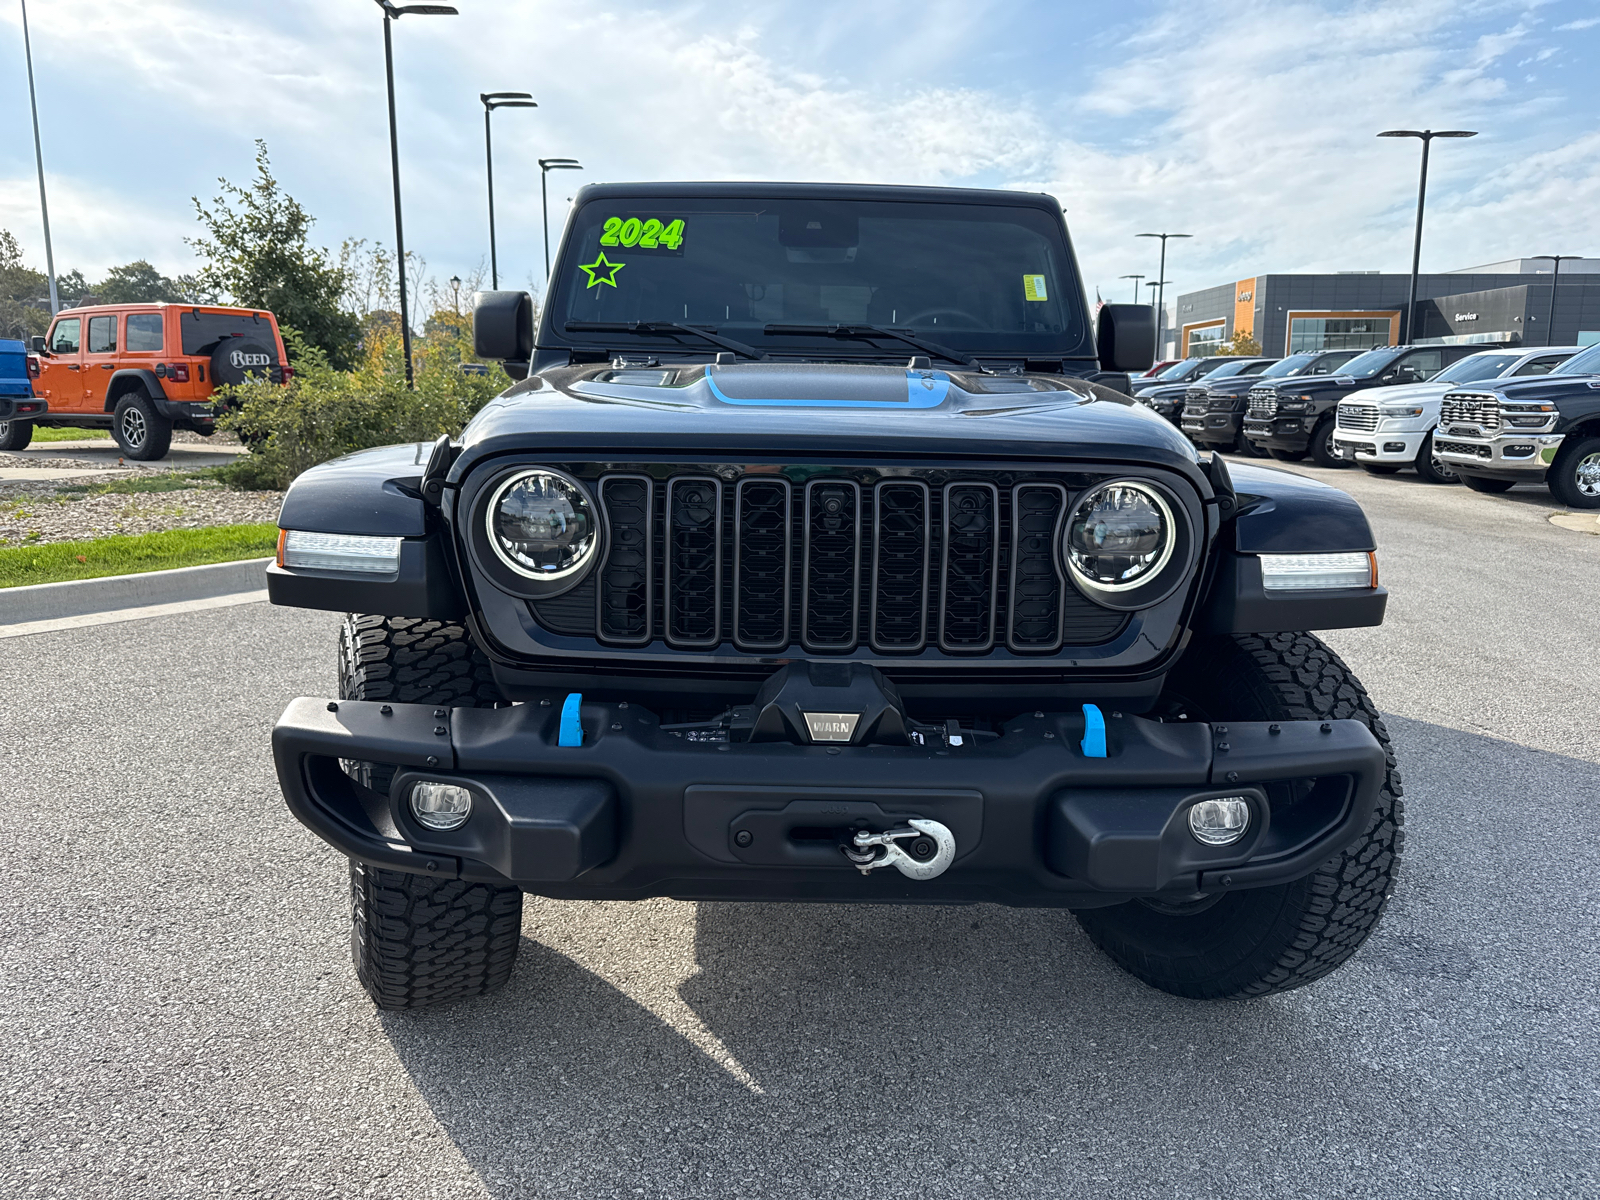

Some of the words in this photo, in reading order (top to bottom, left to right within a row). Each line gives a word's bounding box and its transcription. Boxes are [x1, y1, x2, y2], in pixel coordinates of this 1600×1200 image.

[600, 217, 685, 250] 2024
[1455, 312, 1478, 322] Service
[231, 351, 270, 367] REED
[241, 376, 264, 387] Jp
[1450, 401, 1482, 410] RAM
[813, 722, 849, 732] WARN
[820, 803, 849, 816] Jeep
